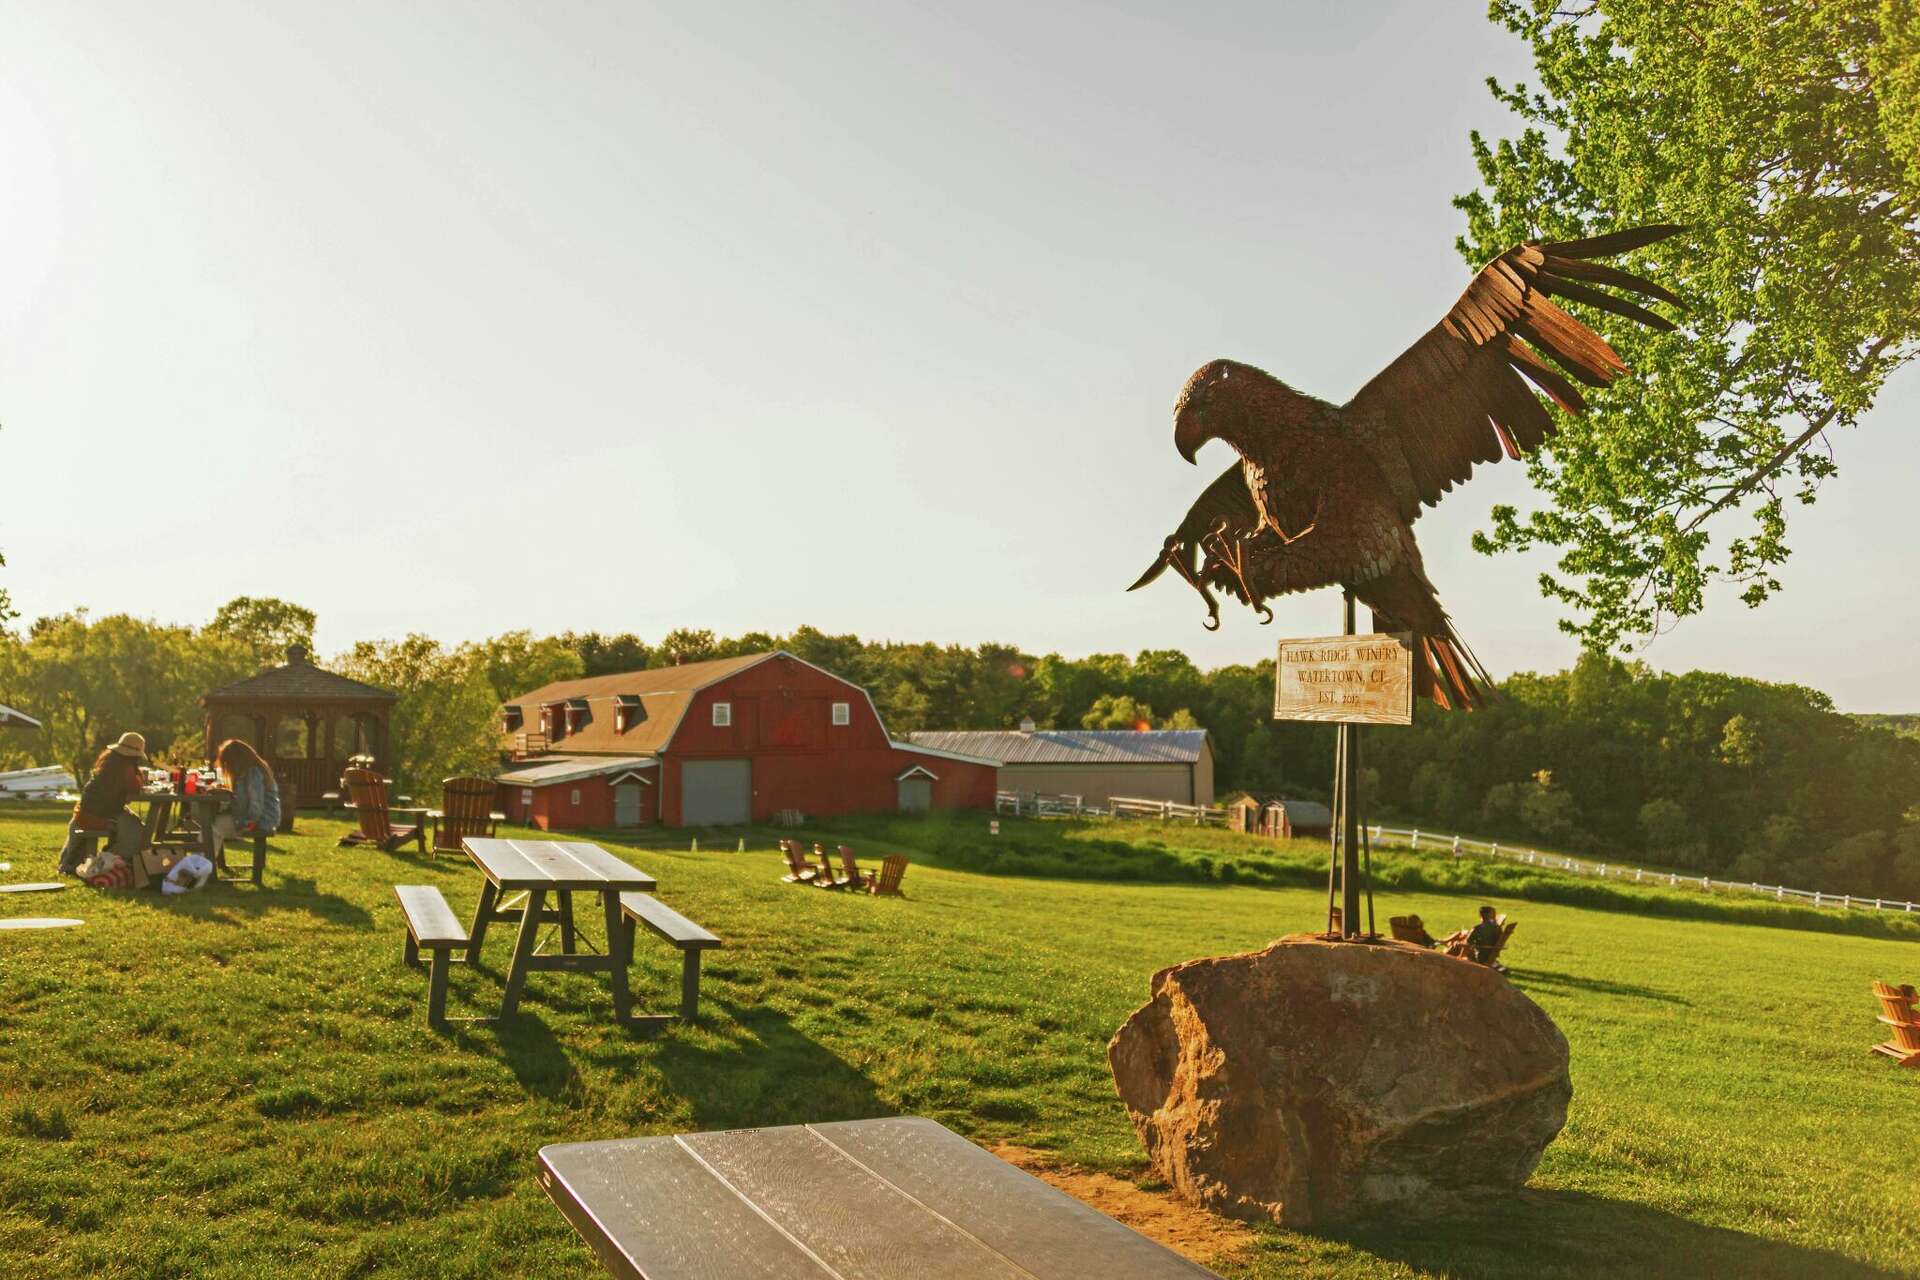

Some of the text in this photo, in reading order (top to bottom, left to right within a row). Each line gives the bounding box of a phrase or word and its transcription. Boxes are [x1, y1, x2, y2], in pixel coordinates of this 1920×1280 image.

[1286, 647, 1399, 662] HAWK RIDGE WINERY
[1370, 669, 1386, 682] CT
